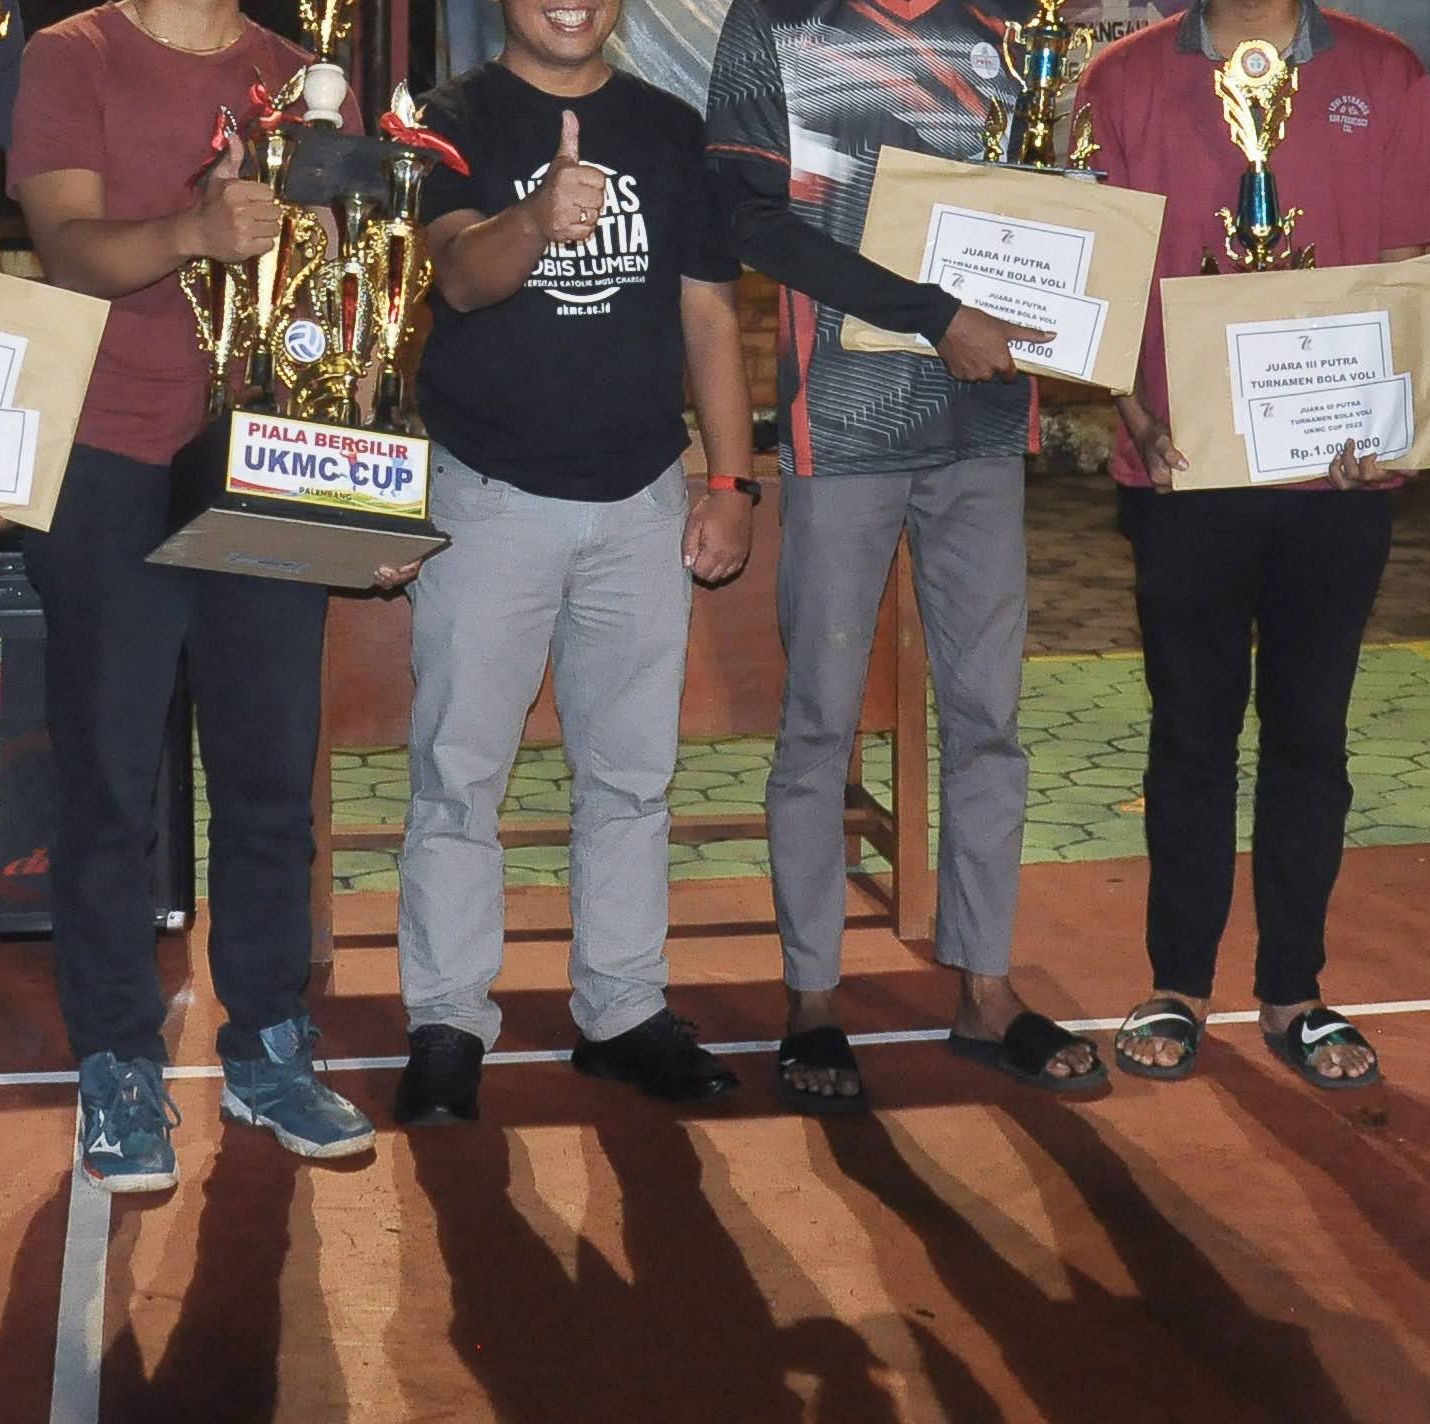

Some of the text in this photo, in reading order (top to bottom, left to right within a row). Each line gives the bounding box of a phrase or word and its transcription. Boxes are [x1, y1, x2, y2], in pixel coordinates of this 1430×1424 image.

[579, 255, 649, 277] LUMEN
[962, 247, 1051, 272] JUARA II PUTRA
[1006, 271, 1037, 285] BOLA
[1040, 277, 1067, 290] VOLI
[974, 299, 1017, 315] TURNAMEN
[1017, 310, 1038, 321] BOLA
[1039, 316, 1058, 326] VOLI
[1022, 300, 1048, 312] PUTRA
[1265, 356, 1359, 373] JUARA III PUTRA
[1251, 370, 1376, 390] TURNAMEN BOLA VOLI
[1336, 400, 1361, 409] PUTRA
[1291, 416, 1332, 425] TURNAMEN
[248, 421, 409, 461] PIALA BERGILIR
[244, 444, 414, 492] UKMC CUP
[298, 486, 353, 502] PALEMBANG
